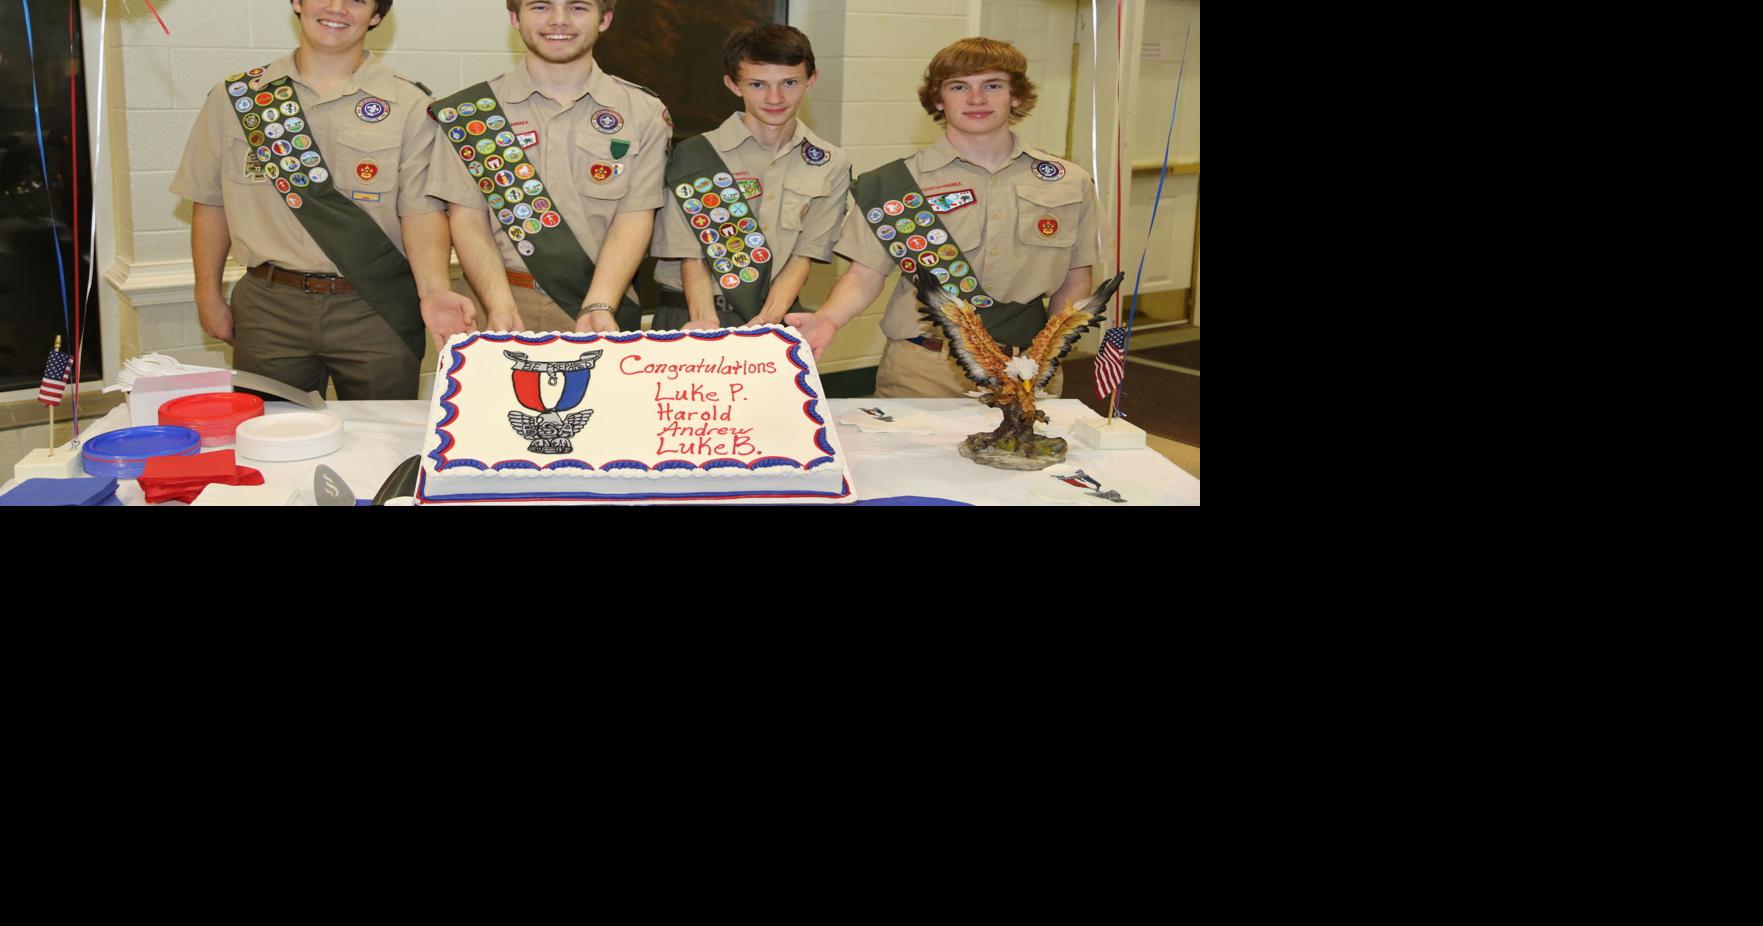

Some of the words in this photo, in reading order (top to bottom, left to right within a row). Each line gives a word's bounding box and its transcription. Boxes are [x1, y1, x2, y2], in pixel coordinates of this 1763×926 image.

[521, 361, 541, 371] BE
[546, 361, 592, 371] PREPARED
[619, 354, 777, 380] Congratulations
[654, 381, 719, 402] Luke
[729, 383, 748, 402] P.
[656, 402, 732, 421] Harold
[656, 420, 754, 437] Andrew
